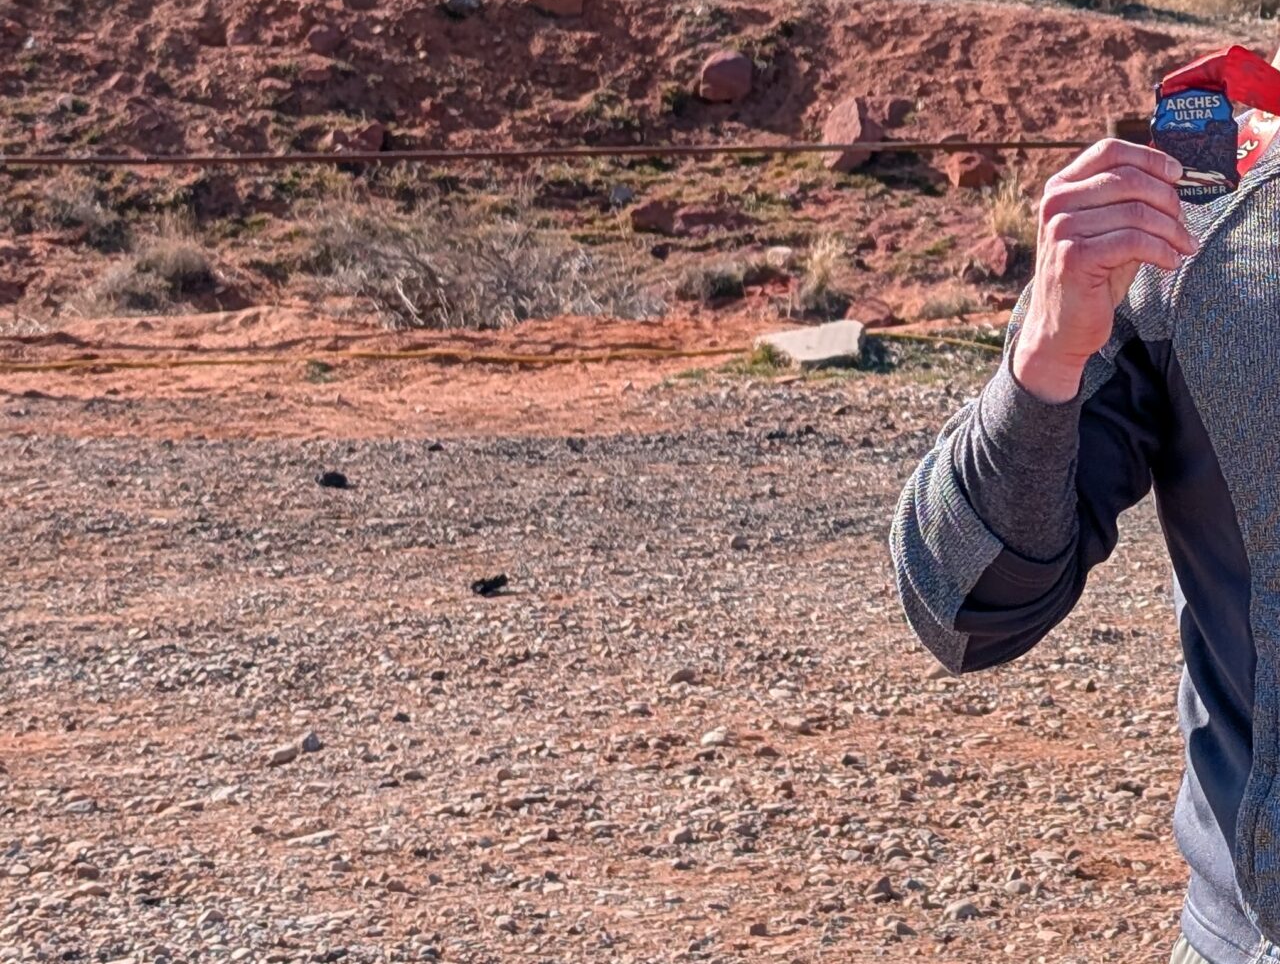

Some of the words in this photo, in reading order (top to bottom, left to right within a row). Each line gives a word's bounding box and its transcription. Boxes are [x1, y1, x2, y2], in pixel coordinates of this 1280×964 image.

[1166, 96, 1221, 111] ARCHES
[1174, 109, 1213, 121] ULTRA
[1178, 185, 1227, 197] INISHER
